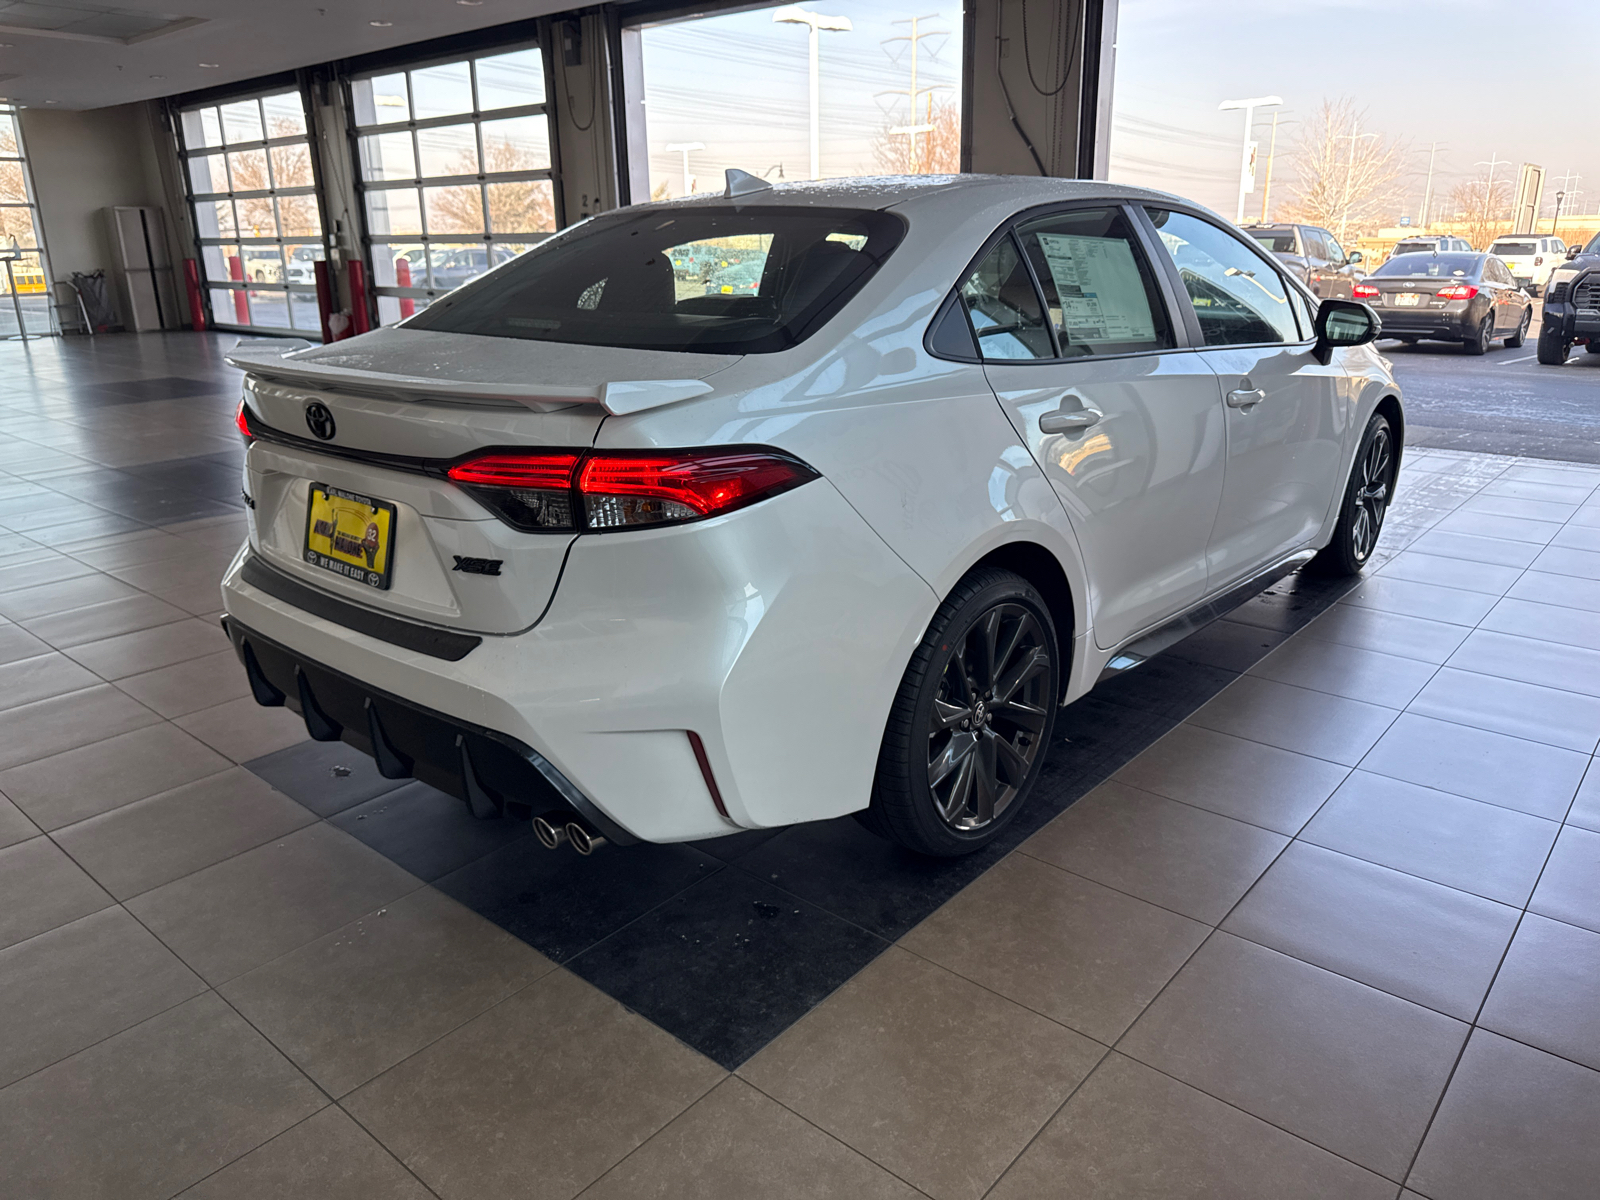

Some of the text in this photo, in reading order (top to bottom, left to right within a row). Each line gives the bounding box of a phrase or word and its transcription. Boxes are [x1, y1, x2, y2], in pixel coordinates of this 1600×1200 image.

[582, 194, 588, 207] 2
[367, 528, 377, 541] 32
[320, 556, 365, 580] WE MAKE IT EASY
[452, 555, 504, 576] XSE
